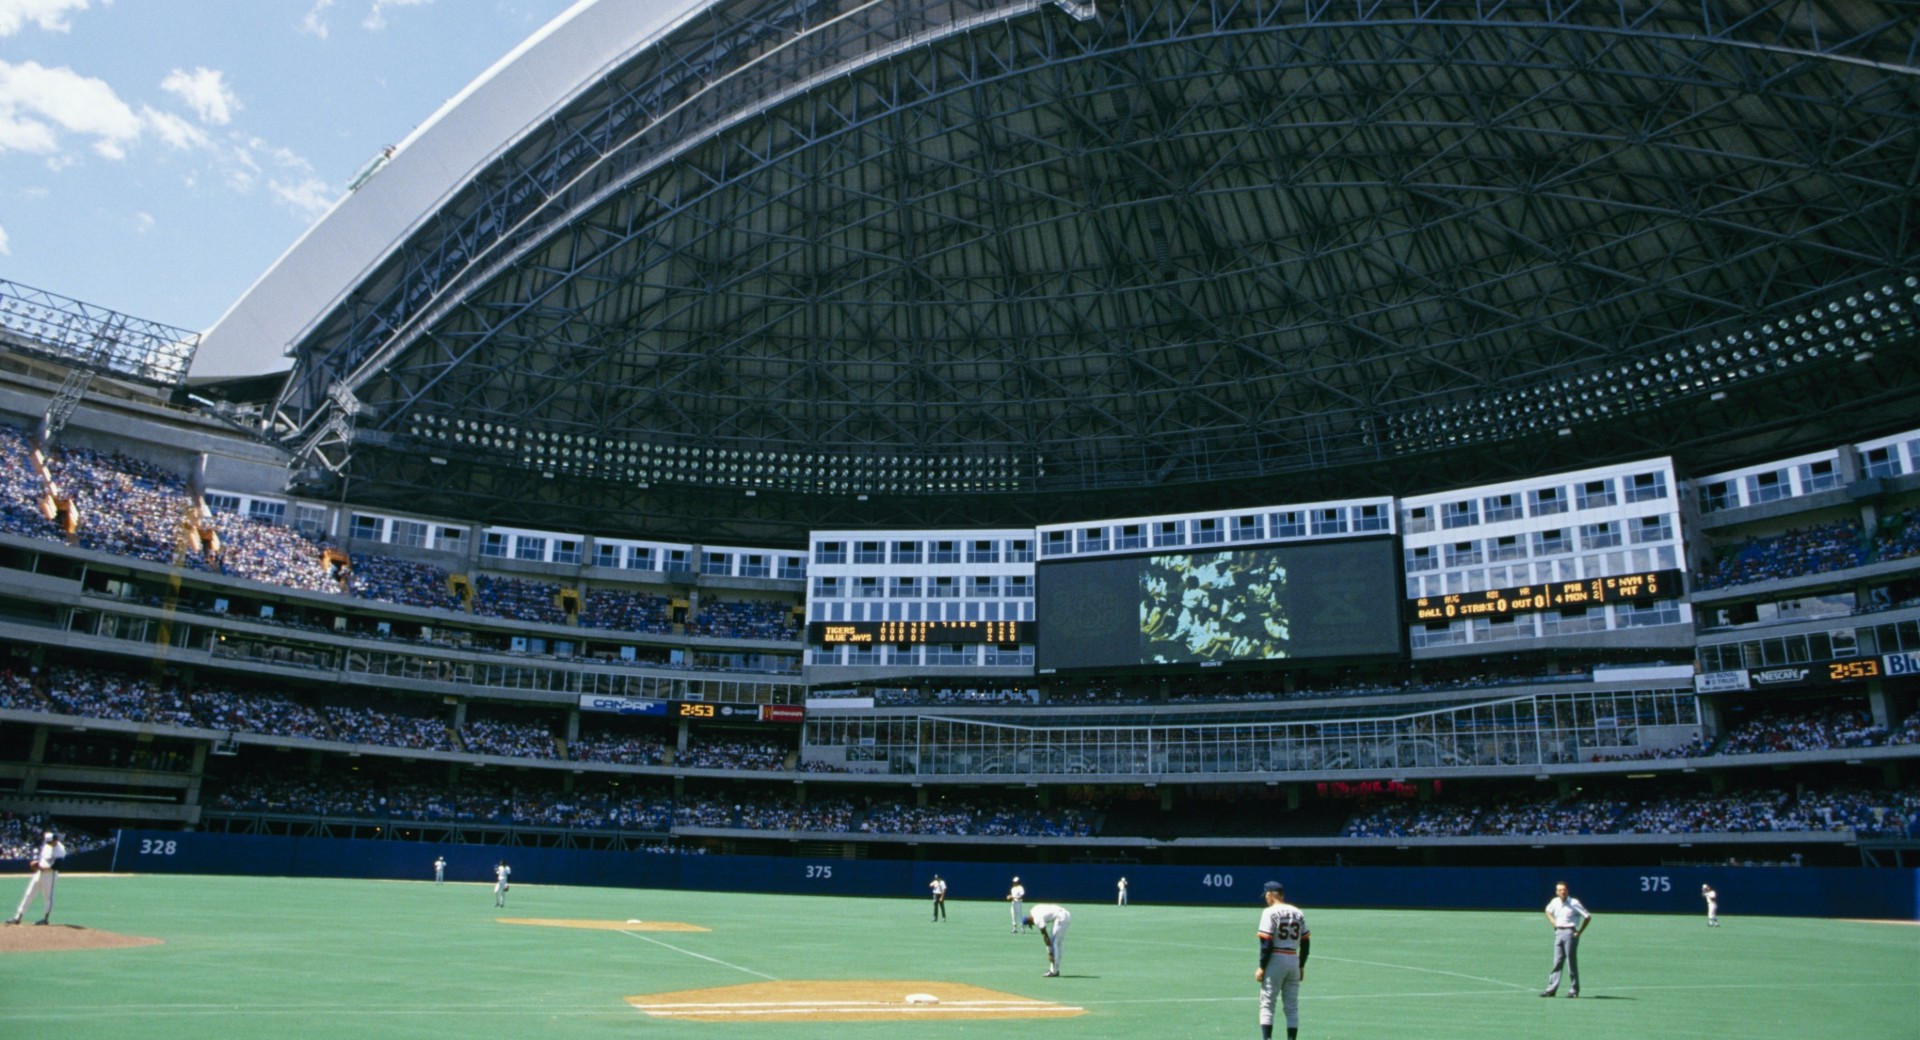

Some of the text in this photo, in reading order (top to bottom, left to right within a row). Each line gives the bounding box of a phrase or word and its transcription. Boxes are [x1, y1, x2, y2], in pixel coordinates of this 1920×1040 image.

[1519, 588, 1530, 596] HR
[1564, 582, 1582, 593] PHI
[1620, 586, 1638, 596] PIT
[1565, 592, 1588, 602] MON
[1418, 595, 1544, 618] BALL 0 STRIKE 0 OUT 0
[1829, 660, 1878, 679] 2:53
[680, 704, 714, 717] 2:53
[140, 839, 177, 855] 328
[806, 865, 832, 878] 375
[1202, 874, 1233, 887] 400
[1640, 876, 1671, 892] 375
[1278, 922, 1300, 940] 53
